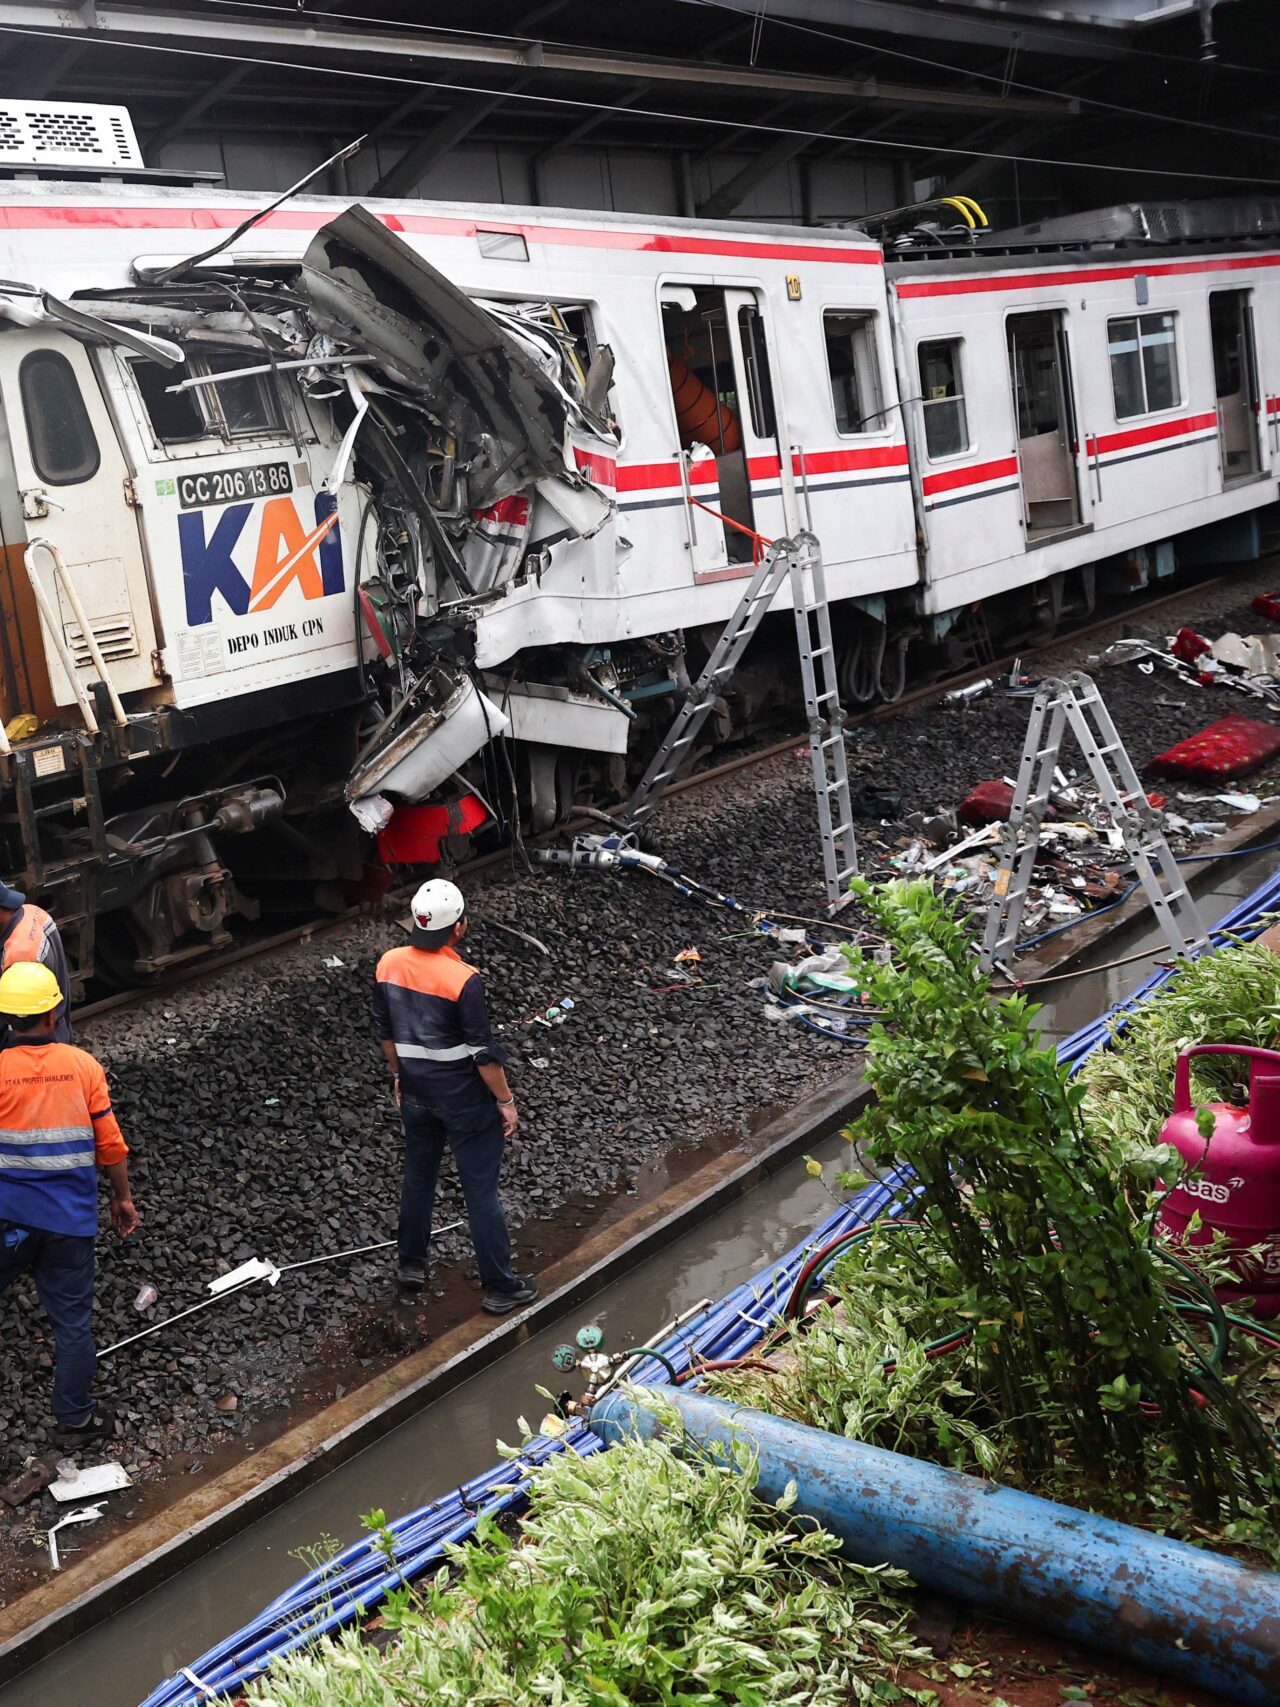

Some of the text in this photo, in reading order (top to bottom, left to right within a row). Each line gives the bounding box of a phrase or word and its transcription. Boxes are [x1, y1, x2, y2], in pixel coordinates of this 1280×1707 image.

[181, 465, 290, 503] CC 206 13 86
[177, 491, 346, 627] KAI
[227, 617, 324, 655] DEPO INDUK CPN
